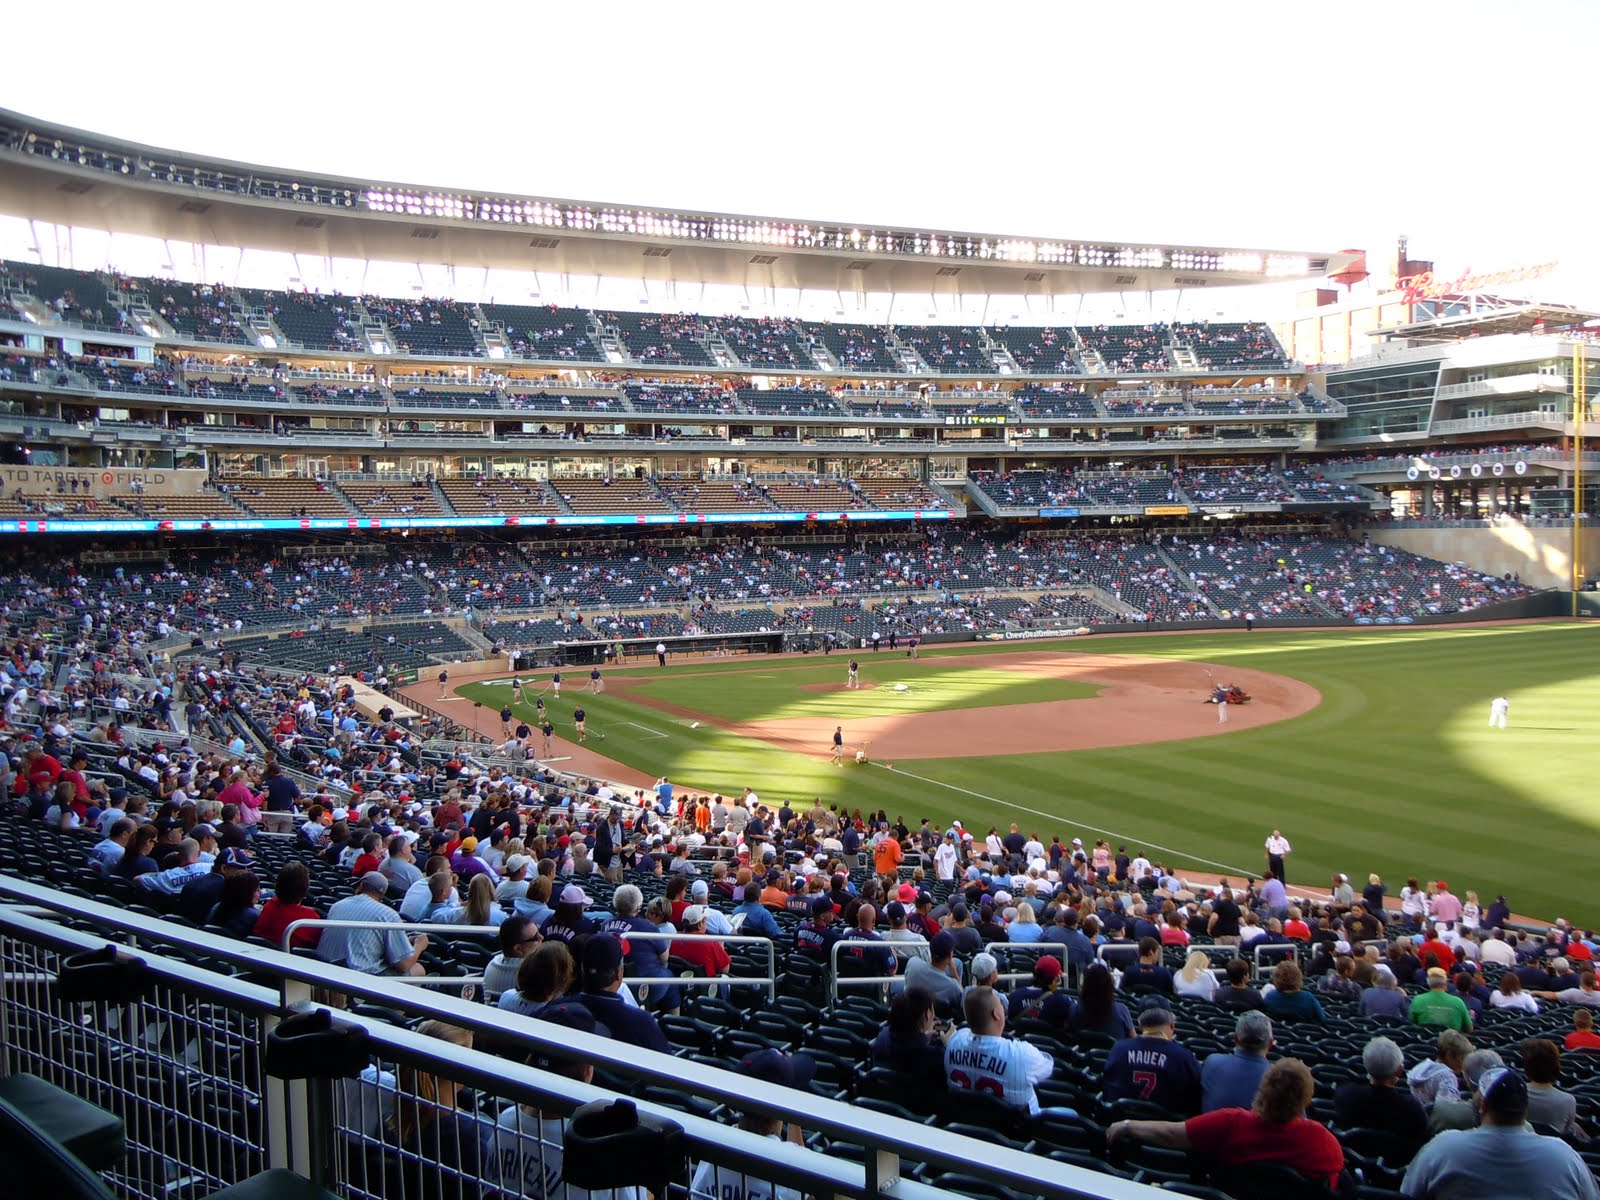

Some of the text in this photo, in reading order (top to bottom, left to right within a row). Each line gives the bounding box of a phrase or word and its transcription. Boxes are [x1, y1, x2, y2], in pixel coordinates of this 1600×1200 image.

[6, 470, 166, 485] TO TARGET FIELD
[546, 925, 576, 940] MAUER
[604, 920, 632, 932] MAUER
[949, 1048, 1007, 1076] MORNEAU
[1127, 1050, 1167, 1067] MAUER
[1132, 1071, 1157, 1100] 7
